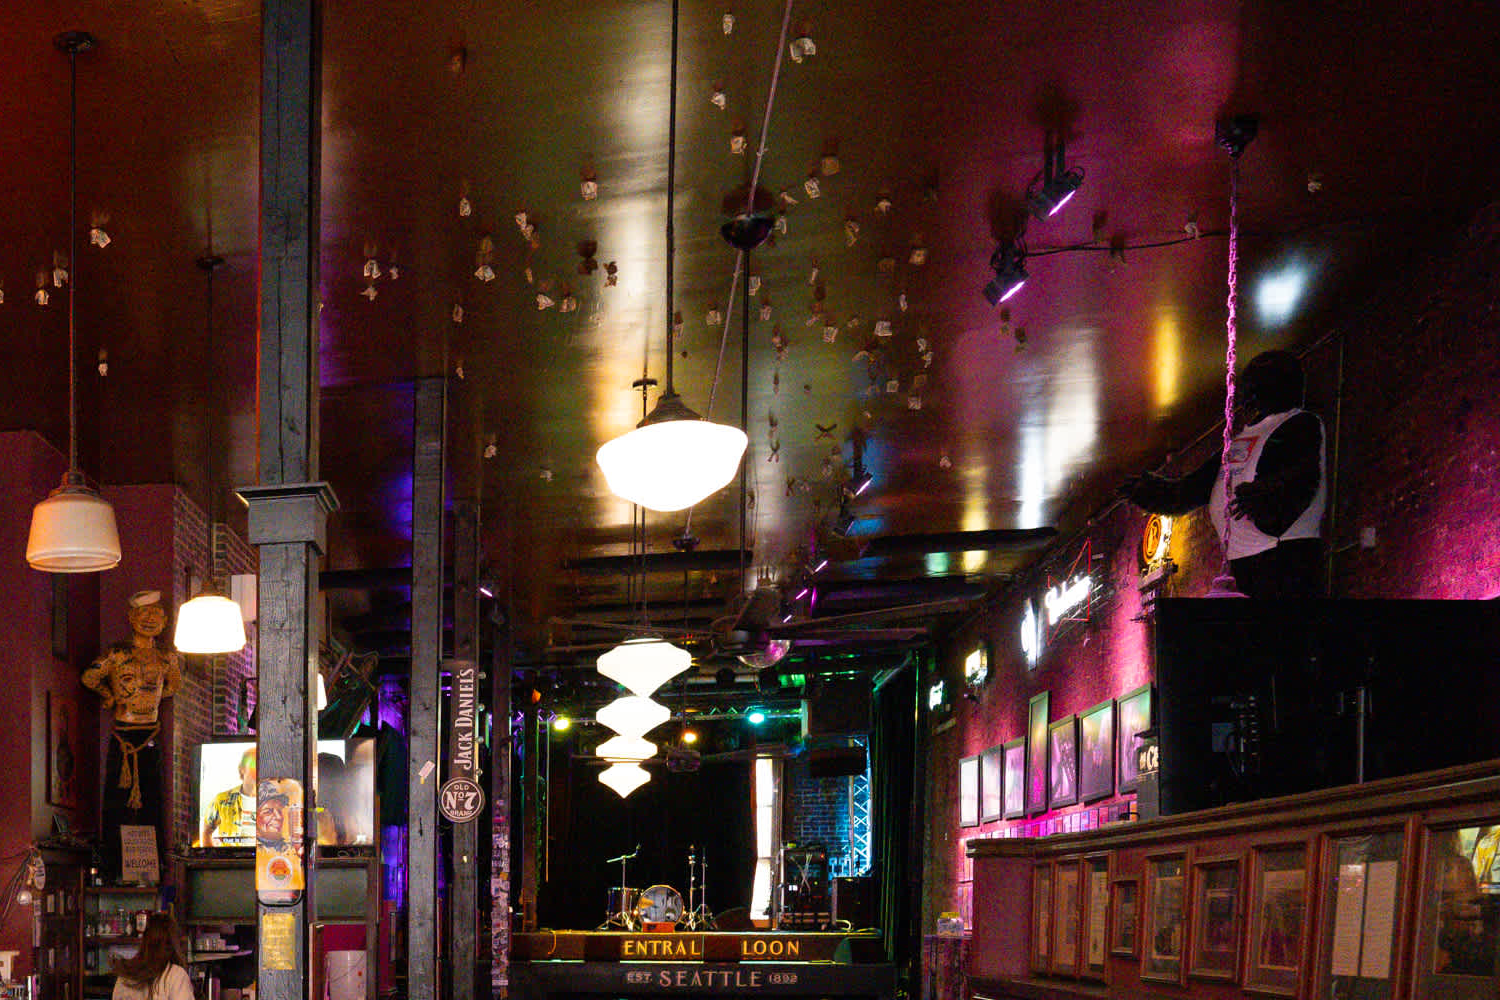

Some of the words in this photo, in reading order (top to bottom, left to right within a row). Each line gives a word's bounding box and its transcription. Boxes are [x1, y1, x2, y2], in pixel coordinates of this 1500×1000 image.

[455, 668, 474, 728] DANIEL'S
[454, 732, 472, 770] JACK
[623, 940, 701, 956] ENTRAL
[742, 940, 800, 956] LOON
[627, 972, 652, 984] EST.
[659, 970, 764, 987] SEATTLE
[768, 973, 798, 984] 1892
